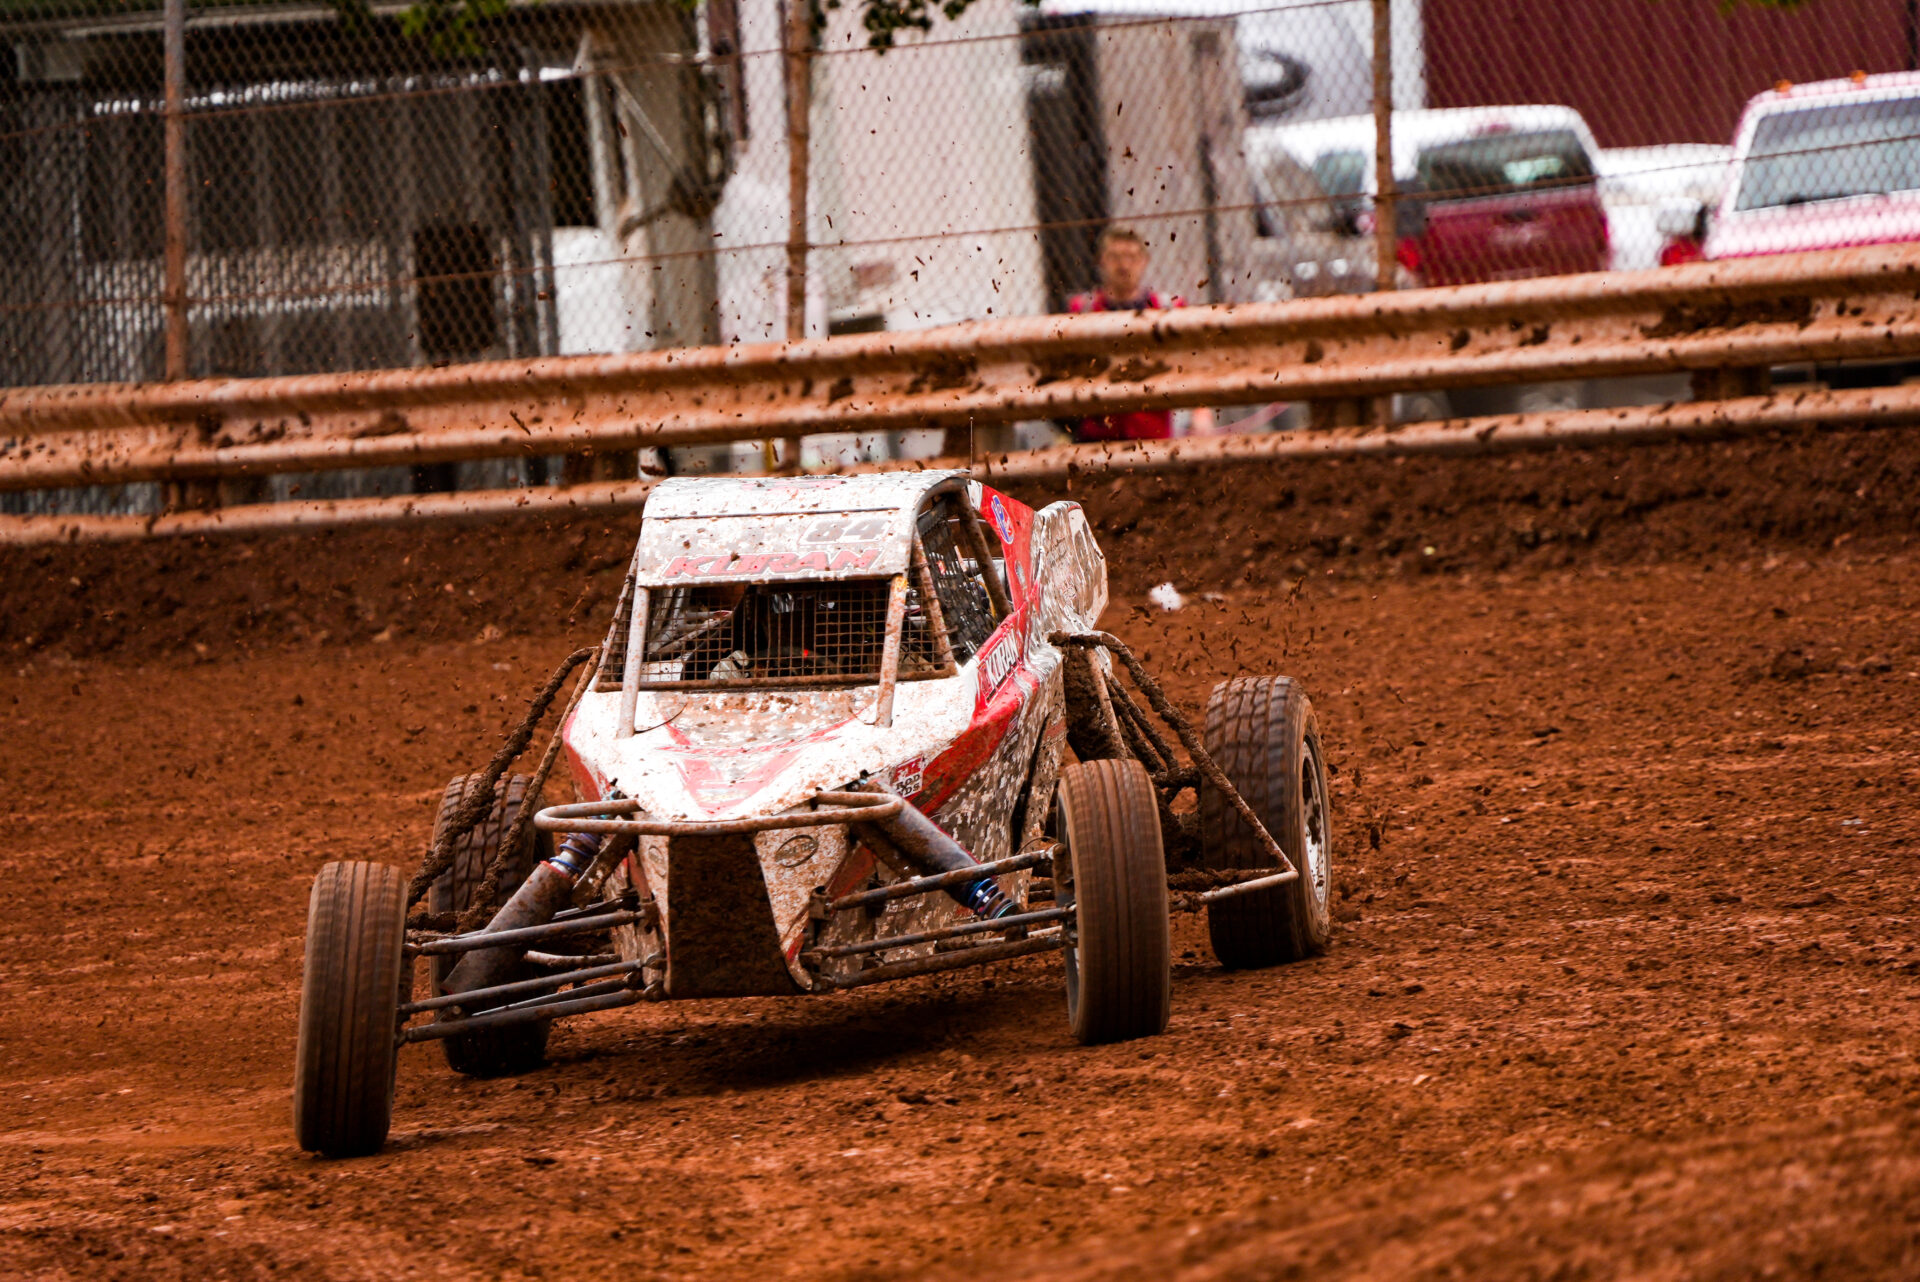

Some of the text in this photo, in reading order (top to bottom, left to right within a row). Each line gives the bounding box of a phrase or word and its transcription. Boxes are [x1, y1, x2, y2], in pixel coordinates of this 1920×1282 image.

[805, 518, 891, 542] 84
[661, 546, 882, 579] KORAN
[984, 627, 1020, 692] KORAN
[895, 773, 921, 791] ROD
